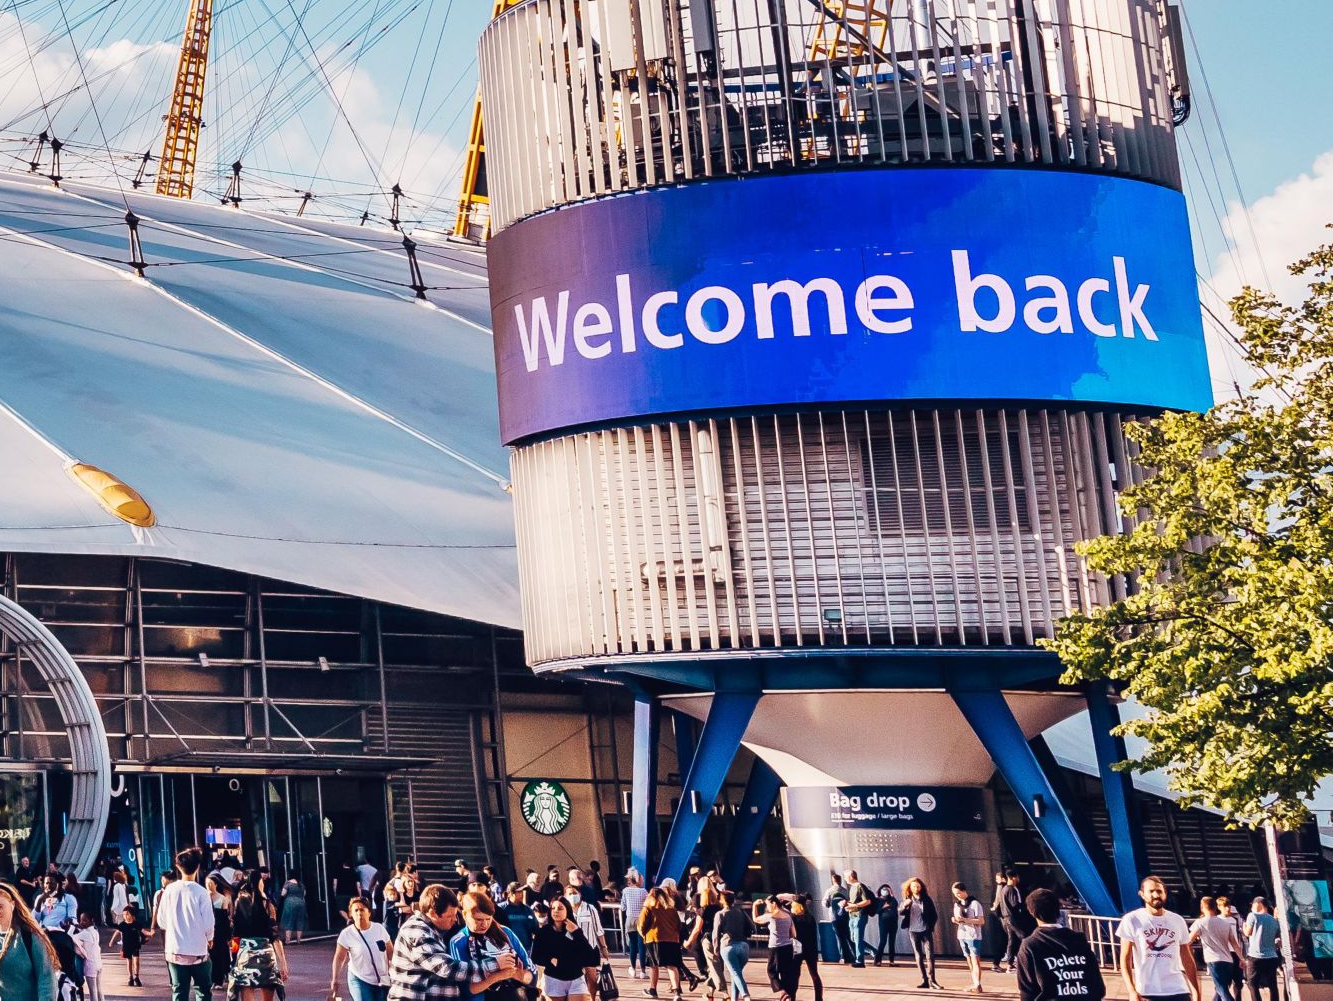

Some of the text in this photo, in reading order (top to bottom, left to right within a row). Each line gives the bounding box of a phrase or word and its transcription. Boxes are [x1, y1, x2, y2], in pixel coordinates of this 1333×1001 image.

[514, 249, 1160, 374] Welcome back
[829, 792, 910, 811] Bag drop
[851, 812, 876, 820] luggage
[881, 812, 897, 820] large
[898, 812, 913, 820] bags
[1044, 954, 1086, 970] Delete
[1053, 969, 1084, 981] Your
[1057, 982, 1088, 996] Idols
